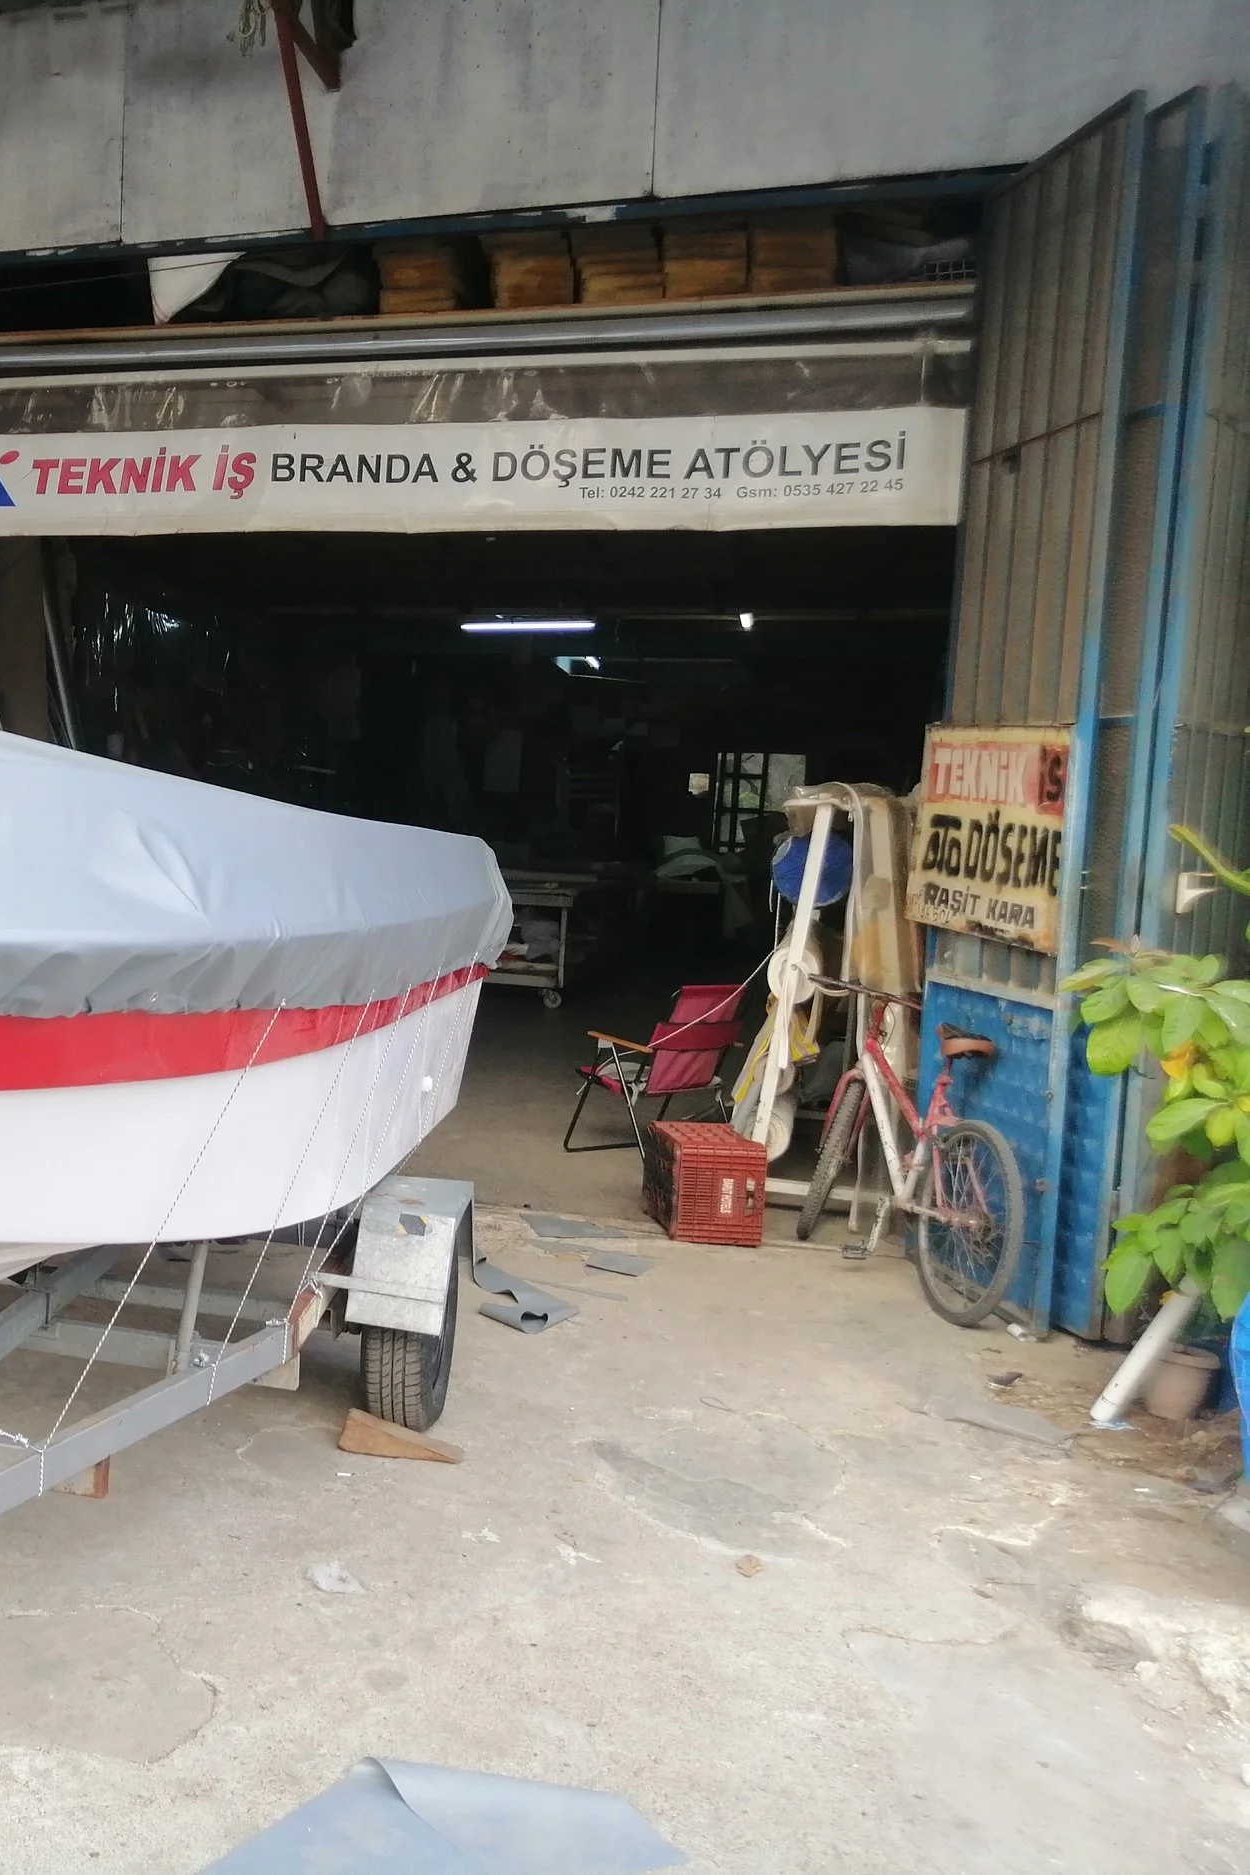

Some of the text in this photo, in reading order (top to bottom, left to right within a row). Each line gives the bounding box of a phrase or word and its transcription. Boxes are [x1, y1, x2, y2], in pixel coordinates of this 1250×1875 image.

[31, 430, 906, 499] TEKNİK İŞ BRANDA & DÖŞEME ATÖLYESİ
[579, 478, 904, 499] Tel: 0242 221 27 34 Gsm: 0535 427 22 45
[923, 881, 981, 916] RAŞİT
[985, 898, 1036, 930] KARA
